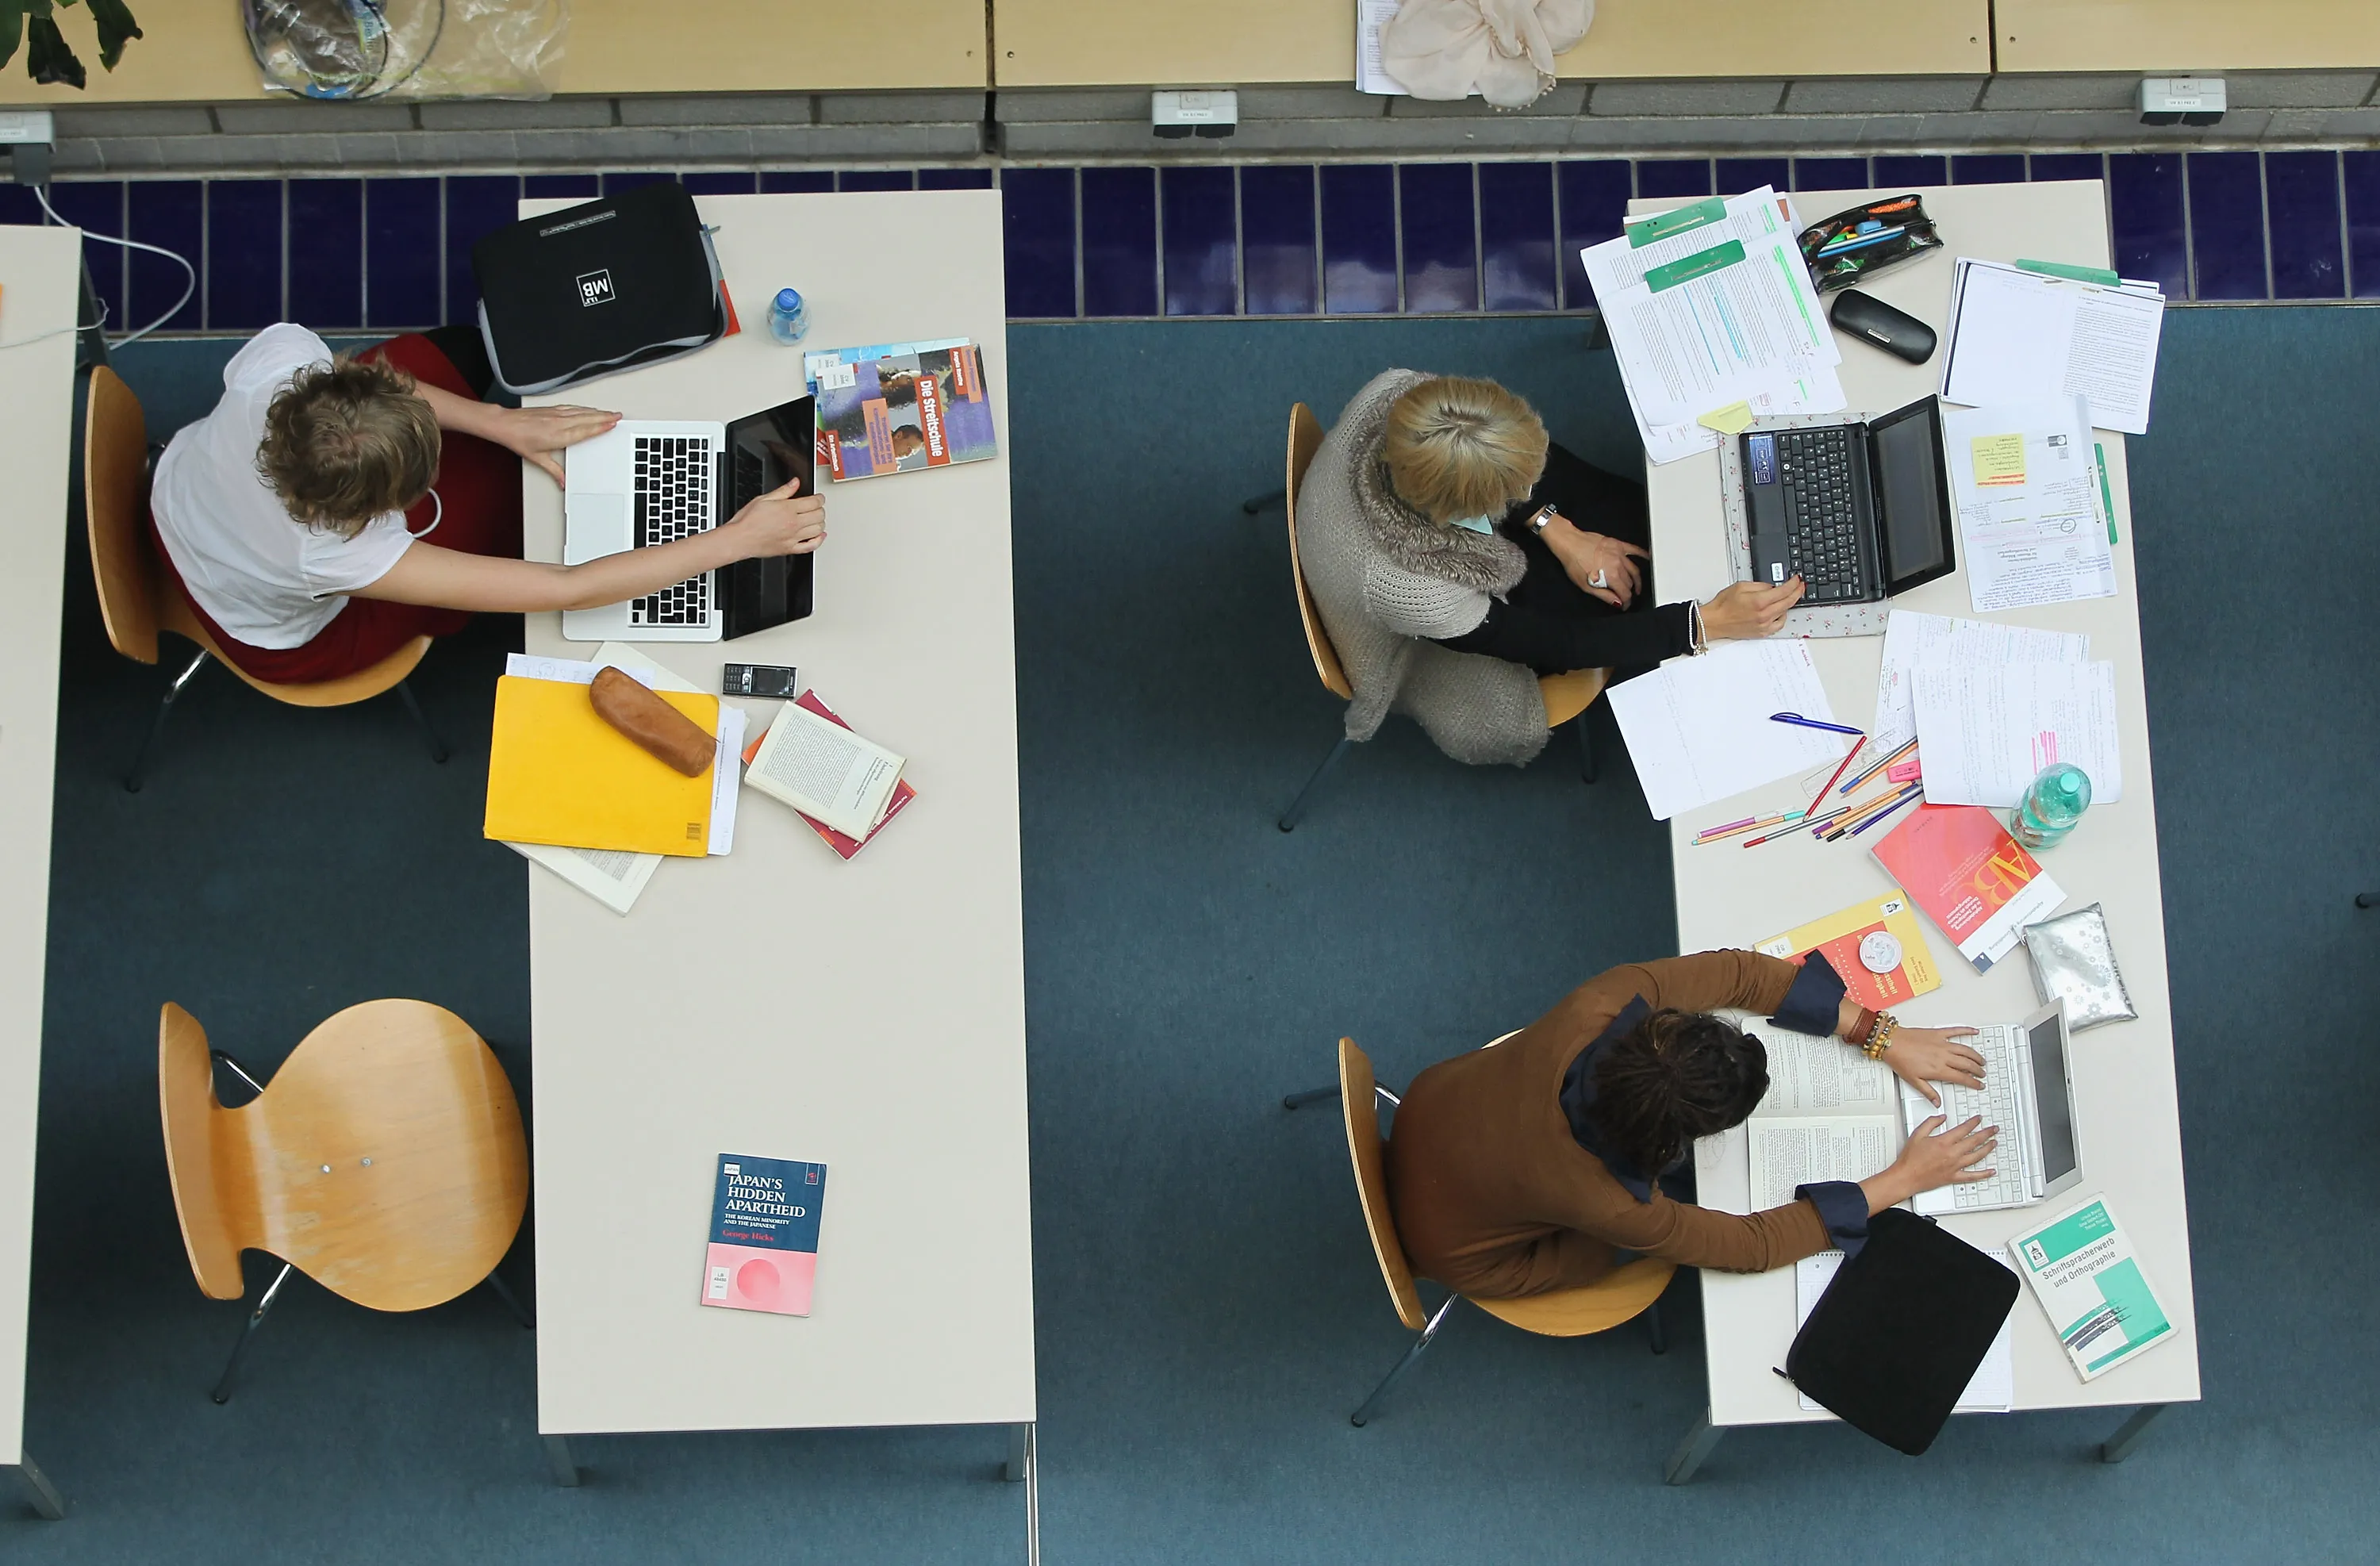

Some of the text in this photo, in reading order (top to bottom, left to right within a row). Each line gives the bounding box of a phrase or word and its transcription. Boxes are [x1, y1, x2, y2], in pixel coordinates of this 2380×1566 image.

[582, 278, 608, 297] MB
[919, 379, 945, 457] Die Streitschule
[1952, 838, 2032, 922] ABC
[728, 1173, 782, 1192] JAPAN'S
[727, 1186, 785, 1203] HIDDEN
[725, 1197, 805, 1219] APARTHEID
[749, 1221, 775, 1230] JAPANESE
[760, 1216, 789, 1226] MINORITY
[721, 1229, 774, 1242] George Hicks
[2041, 1236, 2116, 1280] Schriftspracherwerb
[2052, 1275, 2068, 1288] und
[2067, 1249, 2117, 1281] Orthographie
